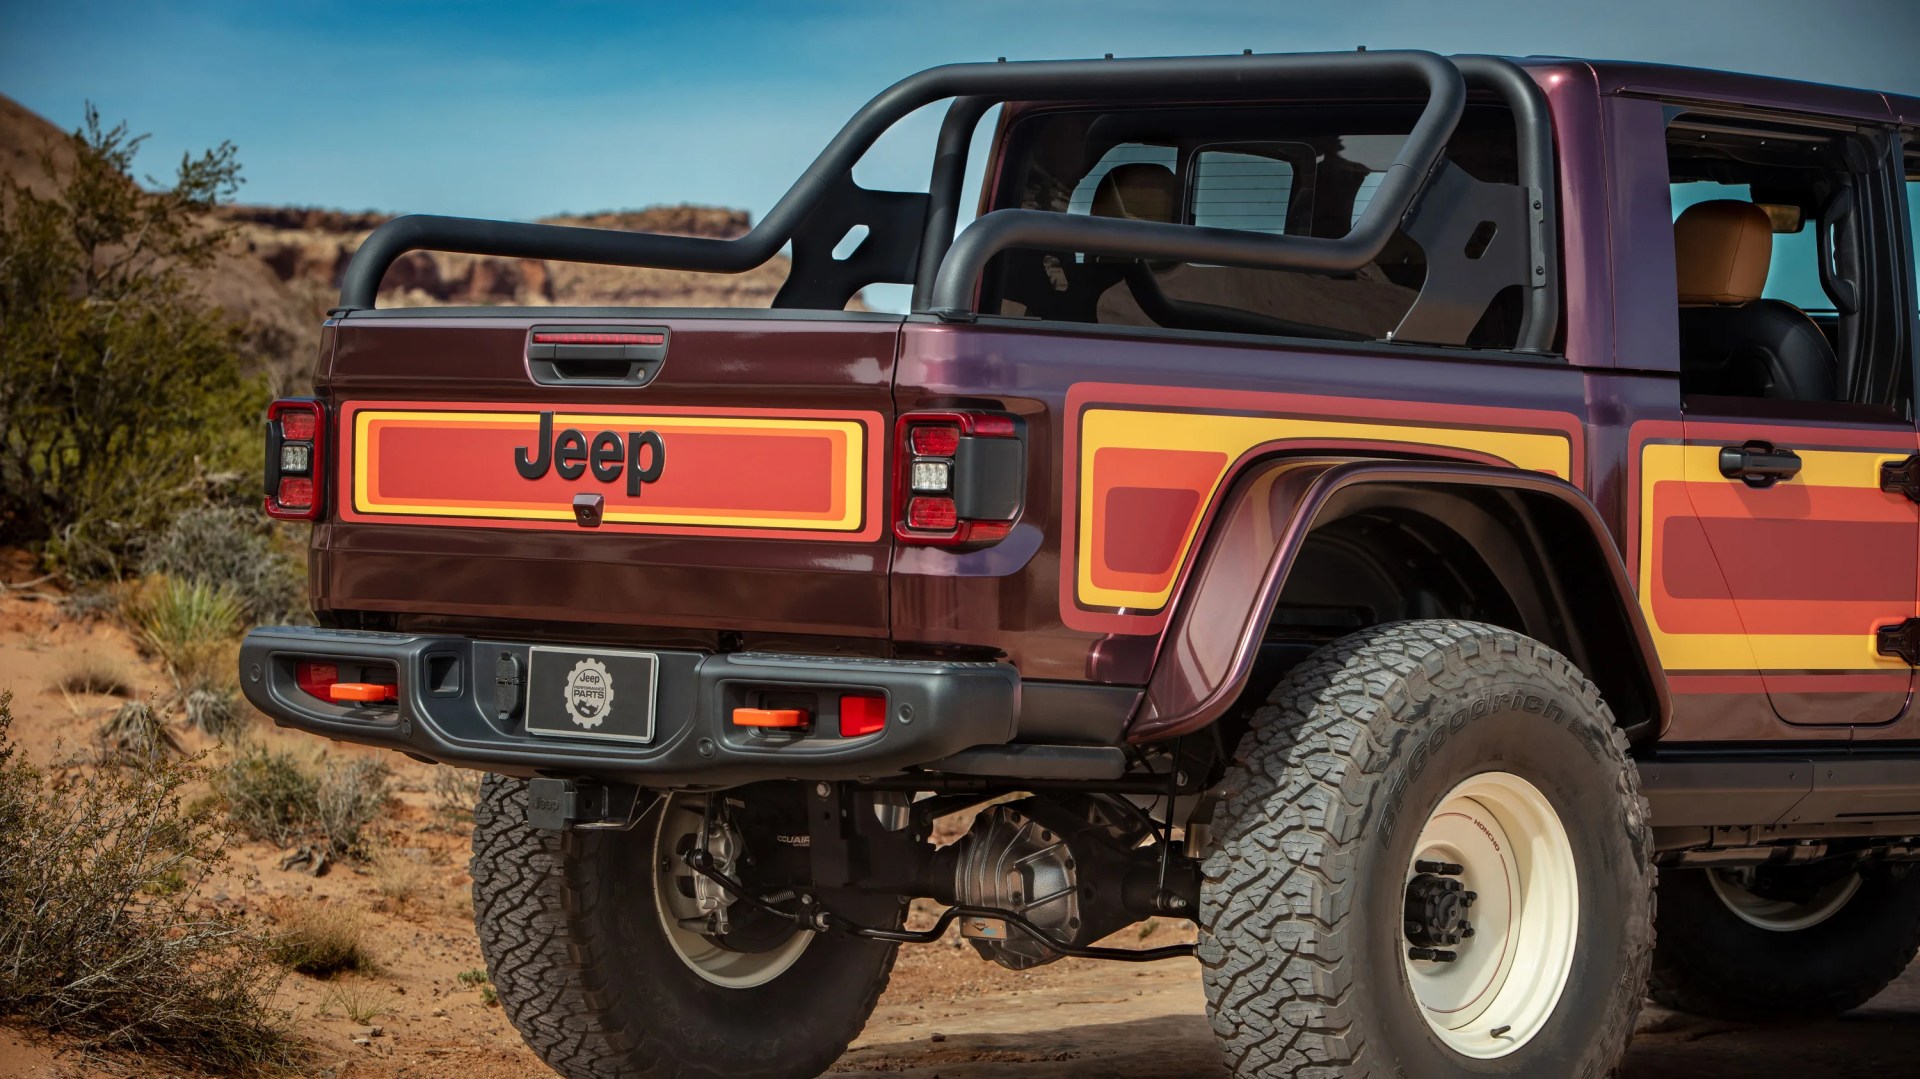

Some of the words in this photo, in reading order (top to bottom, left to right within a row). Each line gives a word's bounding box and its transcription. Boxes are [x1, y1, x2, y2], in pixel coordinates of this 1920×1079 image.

[514, 410, 666, 497] Jeep
[580, 672, 600, 685] Jeep
[574, 690, 604, 699] PARTS
[531, 796, 559, 812] Jeep
[777, 835, 810, 844] CCUAIR
[1473, 819, 1500, 852] HONCHO
